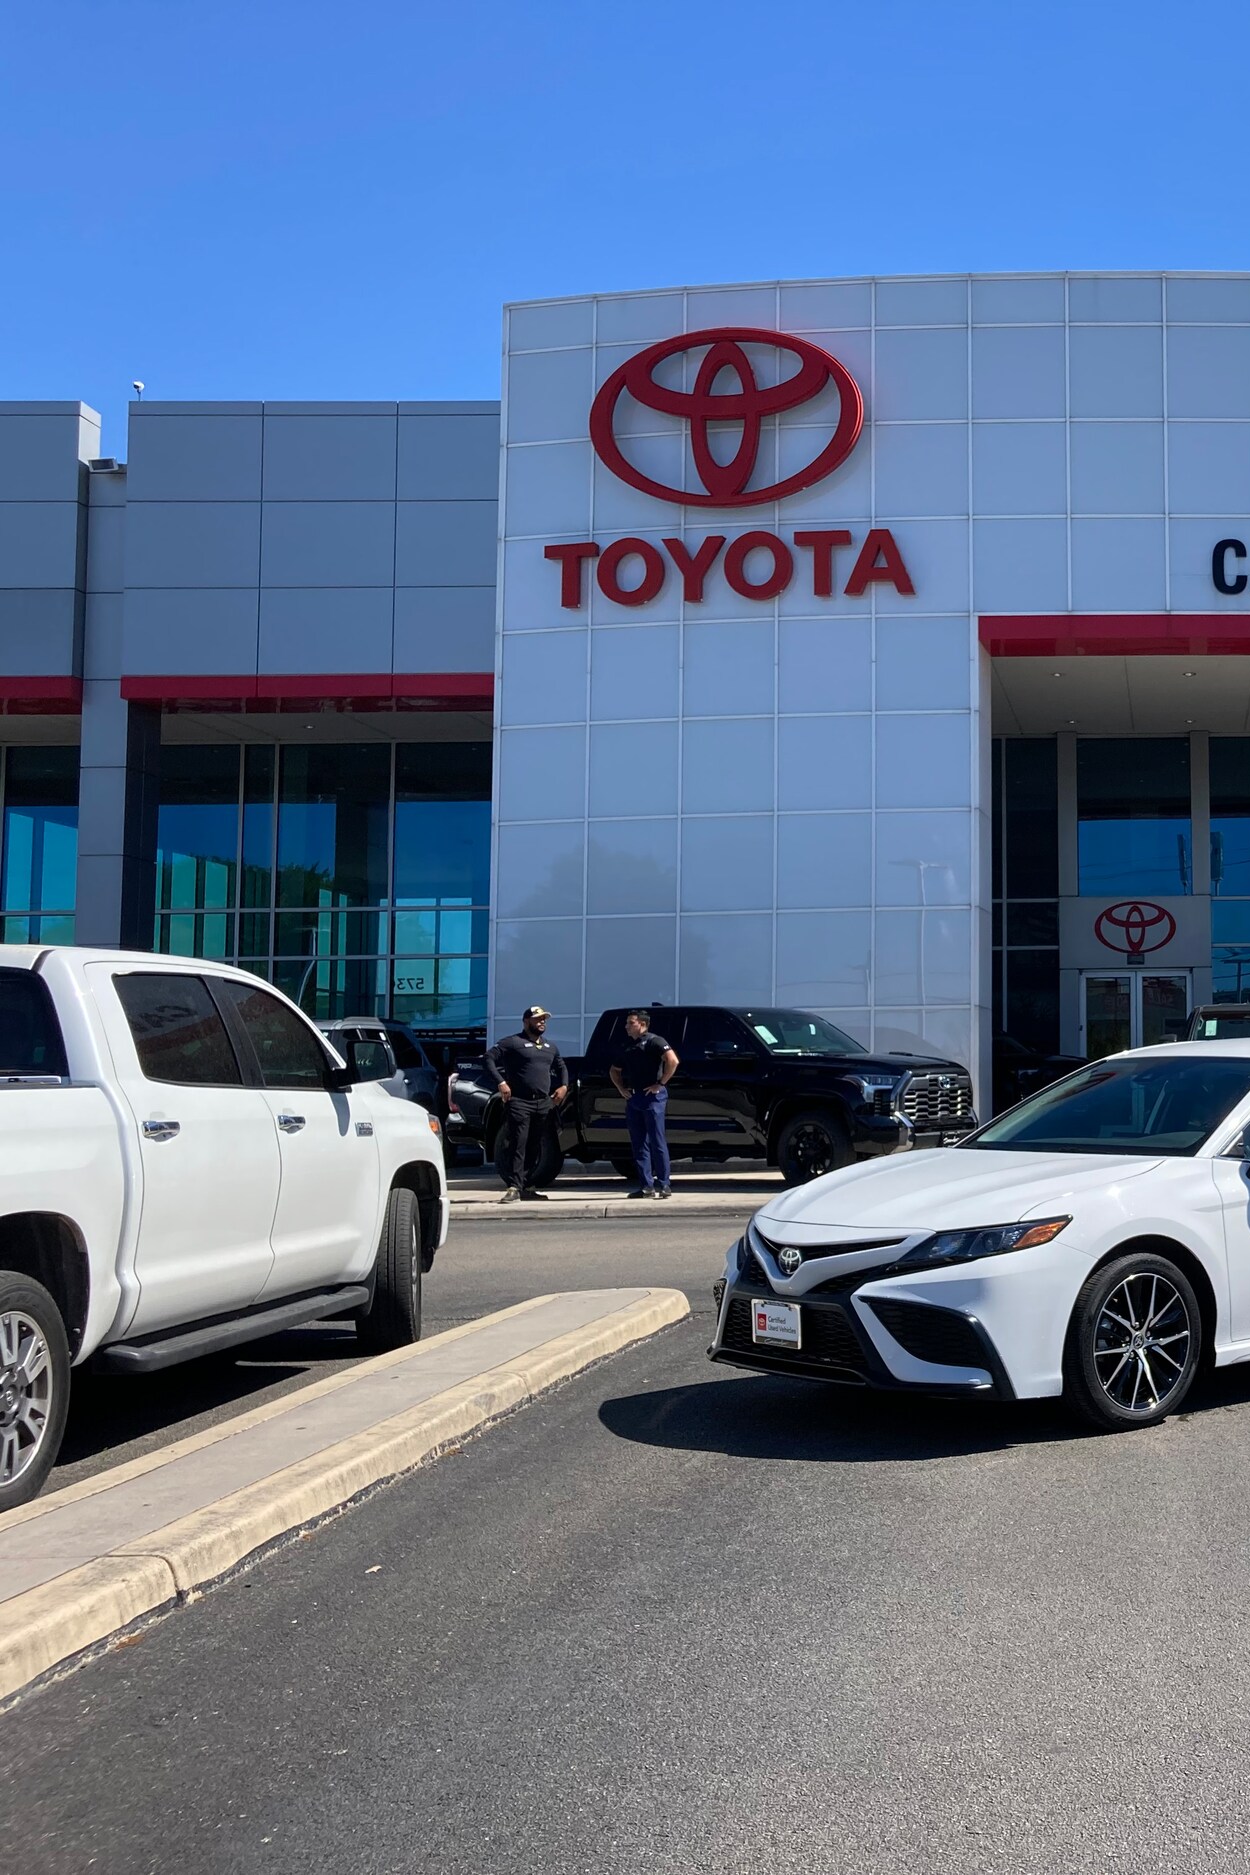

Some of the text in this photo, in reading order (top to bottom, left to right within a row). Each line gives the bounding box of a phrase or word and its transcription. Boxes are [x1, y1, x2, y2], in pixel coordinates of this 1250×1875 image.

[544, 528, 915, 609] TOYOTA
[768, 1316, 786, 1324] Certified
[780, 1326, 796, 1334] Vehicles
